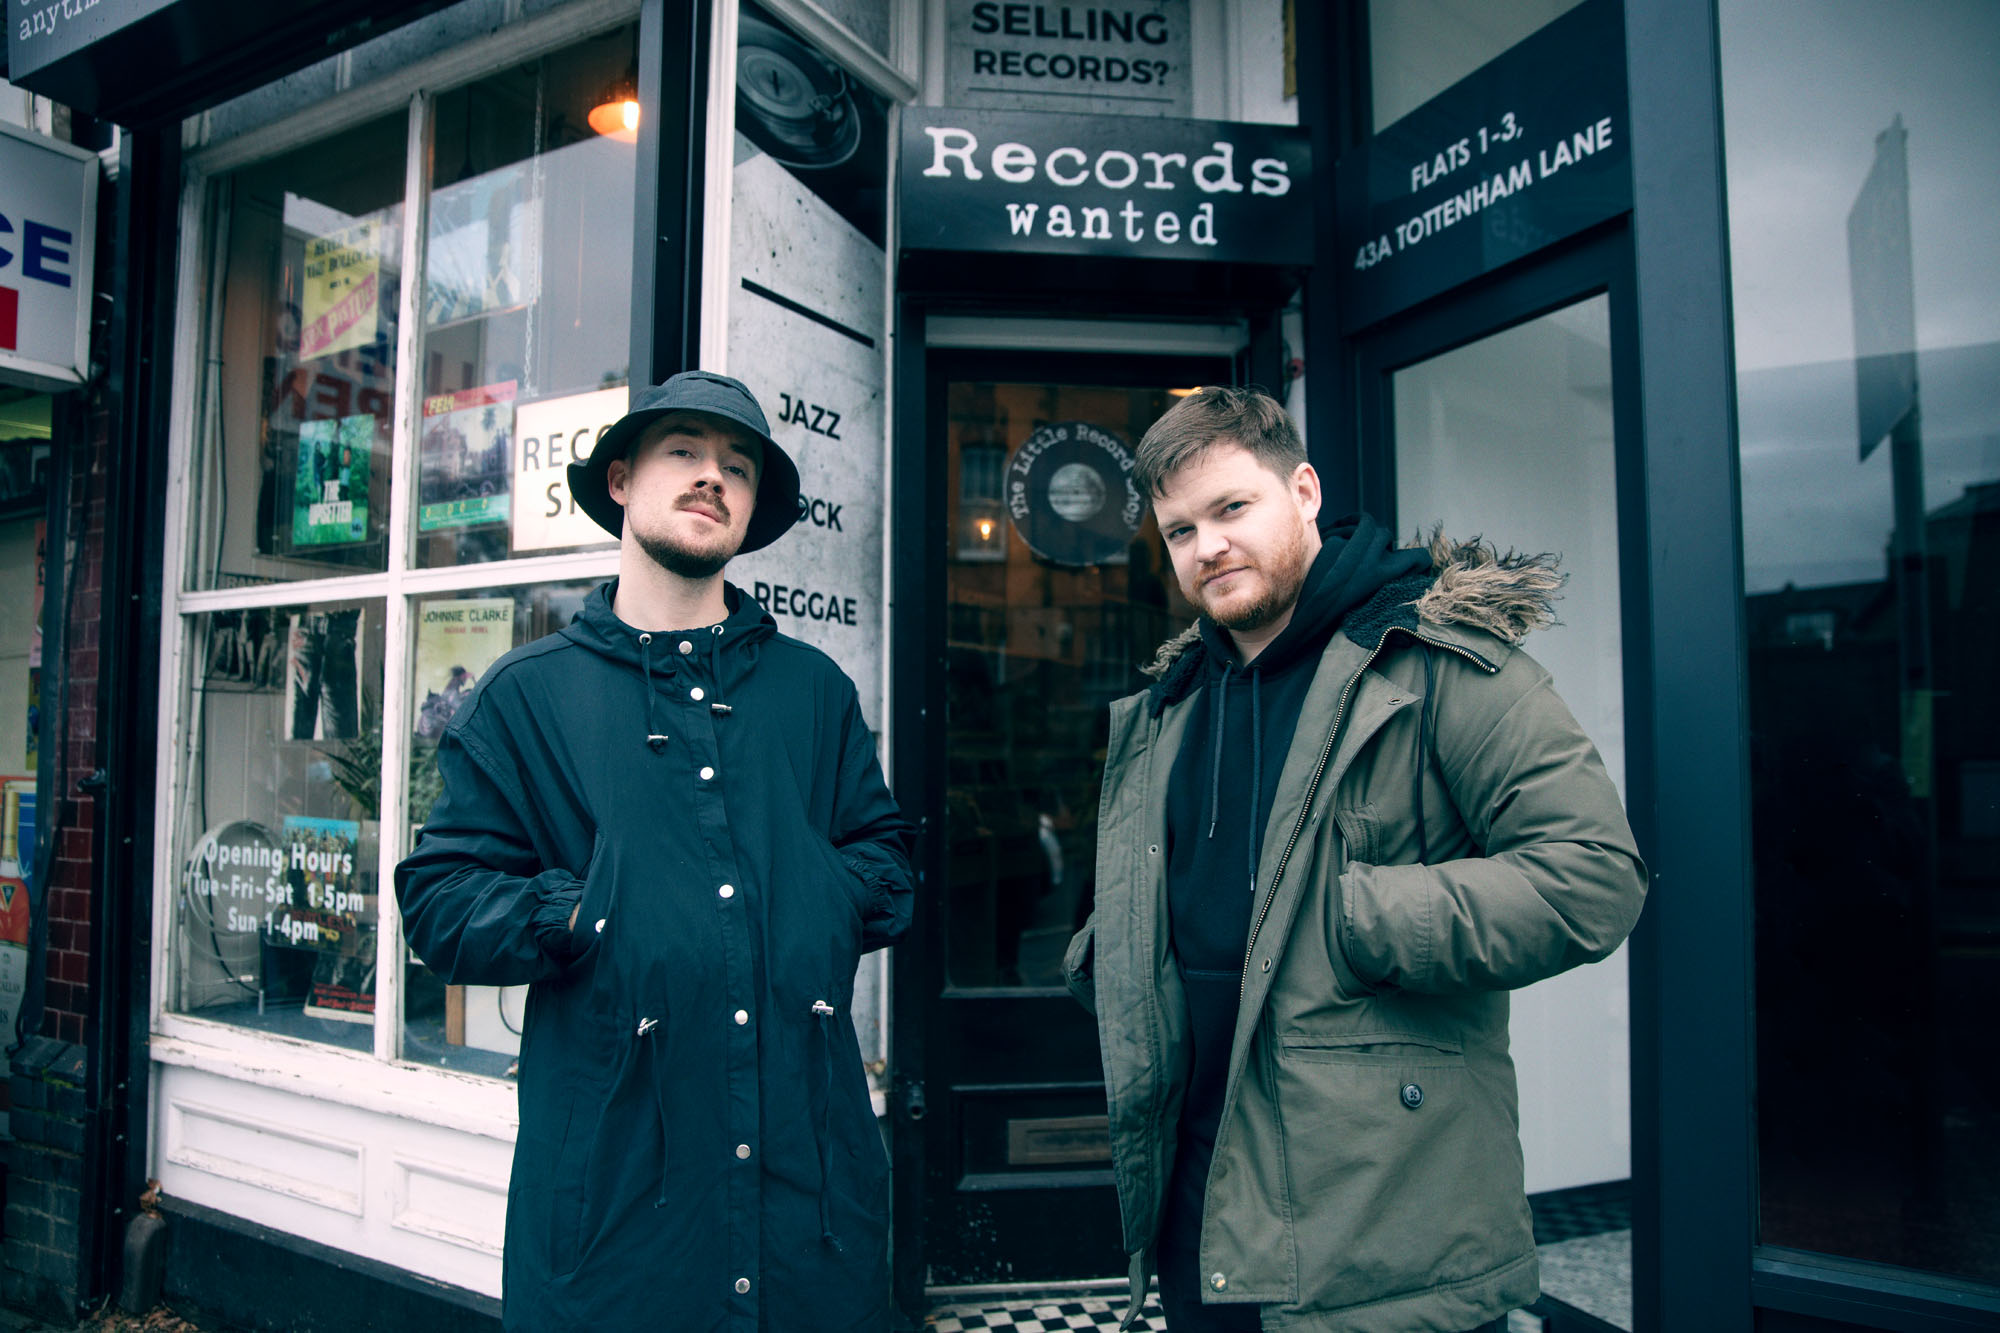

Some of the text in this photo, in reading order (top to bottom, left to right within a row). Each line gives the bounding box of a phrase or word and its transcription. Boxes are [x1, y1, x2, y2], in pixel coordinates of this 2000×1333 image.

[971, 1, 1168, 45] SELLING
[973, 50, 1170, 85] RECORDS?
[923, 127, 1291, 196] Records
[1411, 138, 1470, 193] FLATS
[1354, 235, 1392, 270] 43A
[1396, 159, 1533, 251] TOTTENHAM
[1539, 117, 1613, 178] LANE
[1006, 200, 1218, 246] wanted
[778, 392, 841, 440] JAZZ
[1009, 481, 1030, 519] The
[1075, 424, 1136, 472] Record
[545, 482, 576, 518] S
[798, 493, 844, 533] OCK
[468, 608, 510, 622] CLARKE
[754, 581, 857, 626] REGGAE
[204, 838, 353, 876] Opening Hours
[306, 883, 364, 917] 1-5pm
[227, 907, 319, 946] Sun 1-4pm
